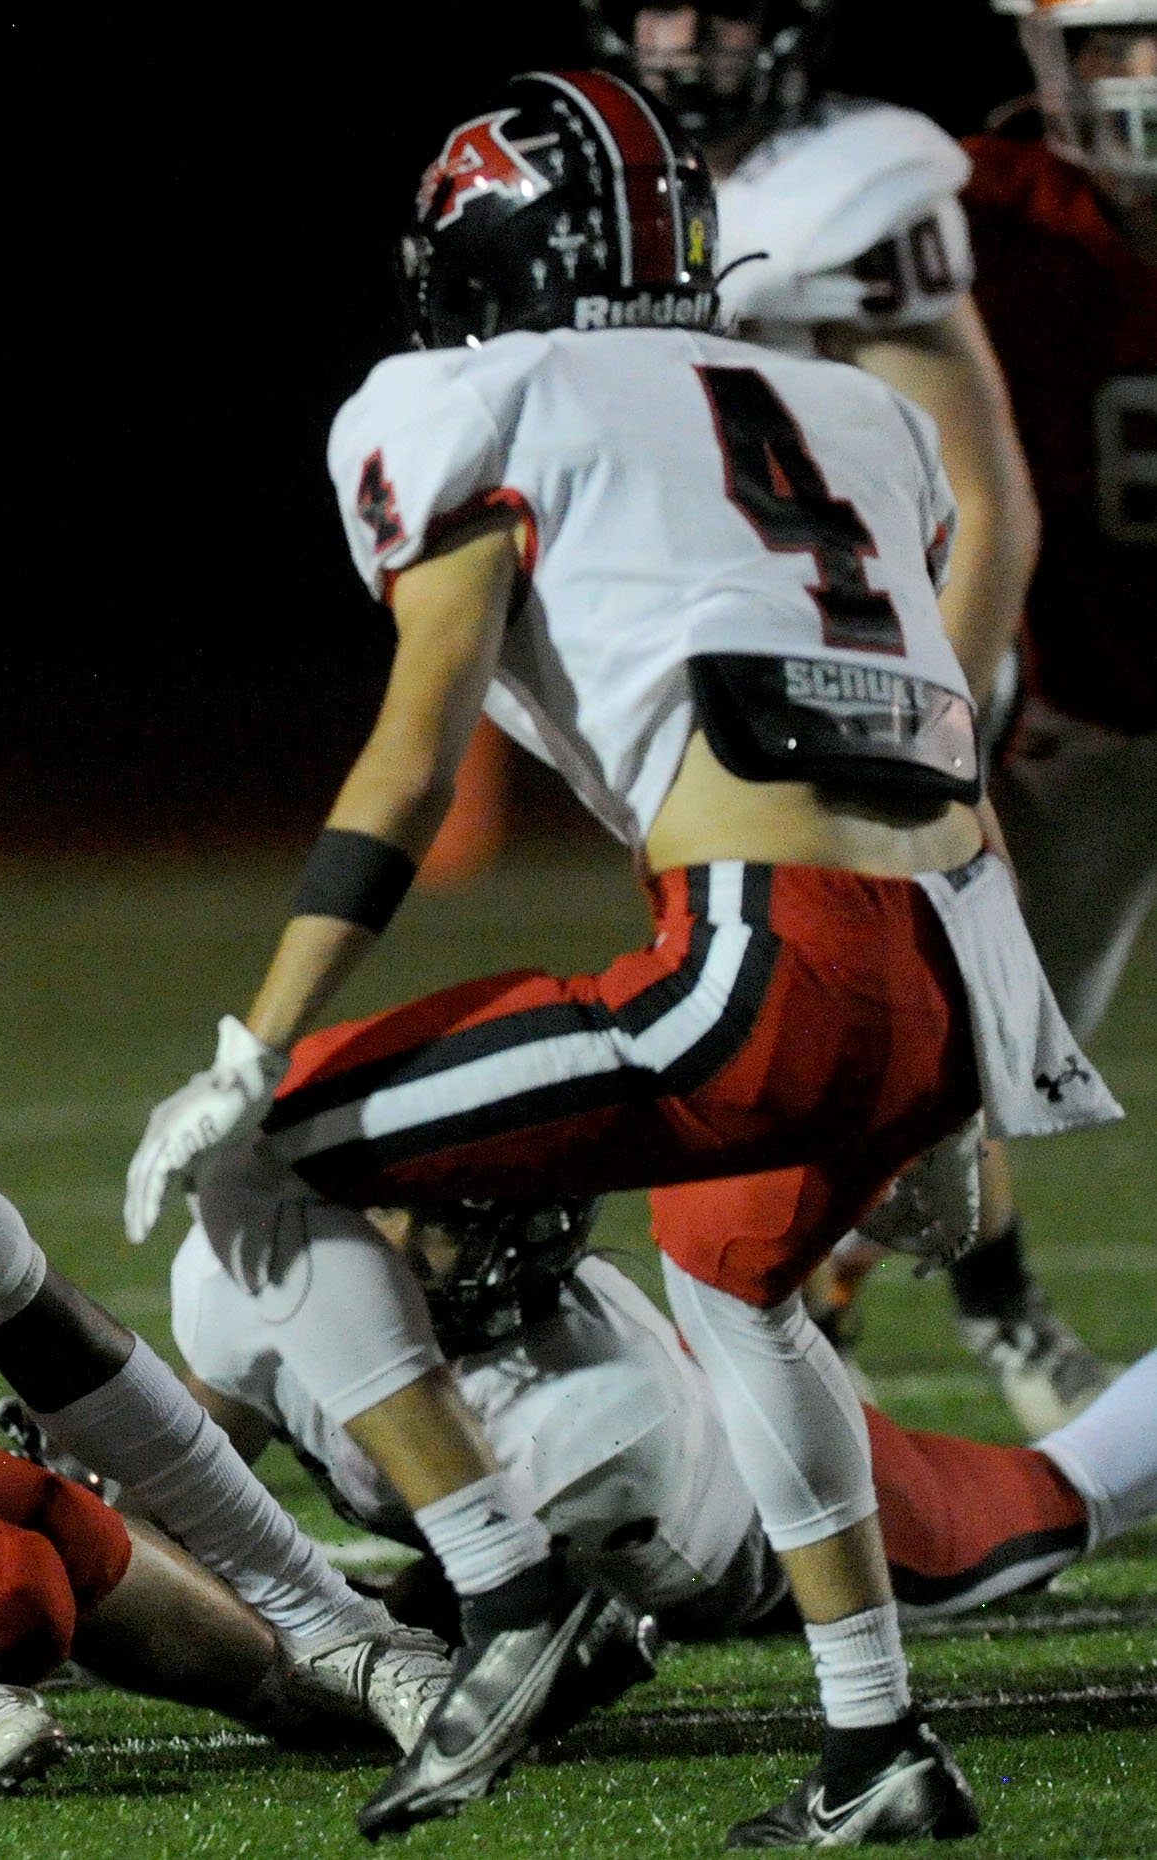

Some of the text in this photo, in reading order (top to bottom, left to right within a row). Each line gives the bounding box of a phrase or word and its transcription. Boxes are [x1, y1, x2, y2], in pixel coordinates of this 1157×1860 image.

[575, 291, 713, 330] Riddell
[356, 449, 408, 554] 4
[691, 363, 907, 658] 4
